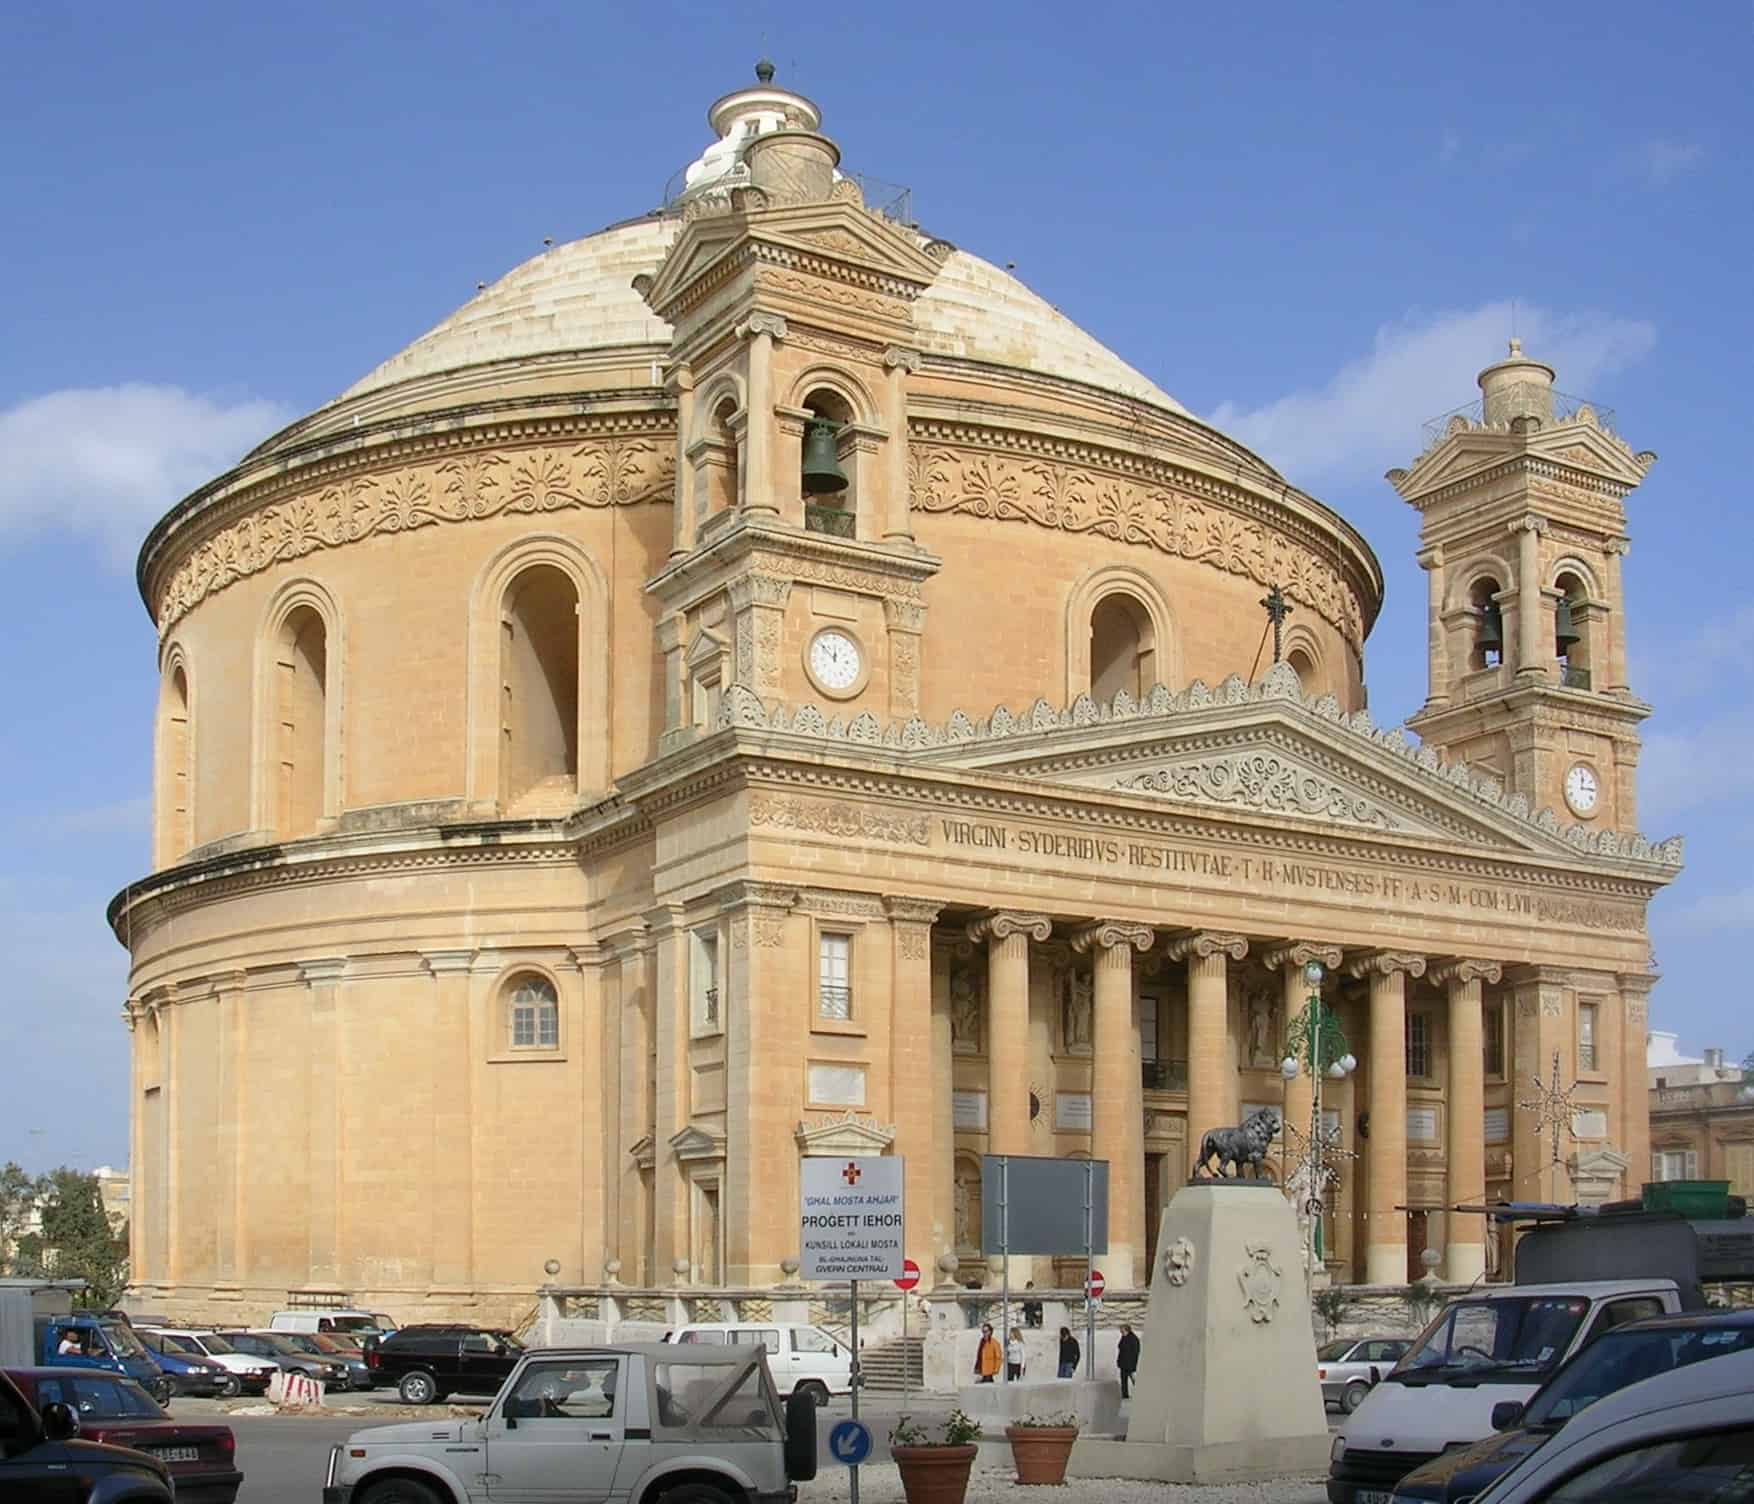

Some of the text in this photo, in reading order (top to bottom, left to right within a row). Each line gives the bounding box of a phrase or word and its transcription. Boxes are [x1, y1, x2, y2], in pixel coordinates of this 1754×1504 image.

[942, 819, 1006, 848] VIRGINI
[1018, 830, 1118, 863] SYDERIBVS
[1241, 858, 1252, 879] T
[1263, 861, 1273, 881] H
[871, 1239, 899, 1249] MOSTA
